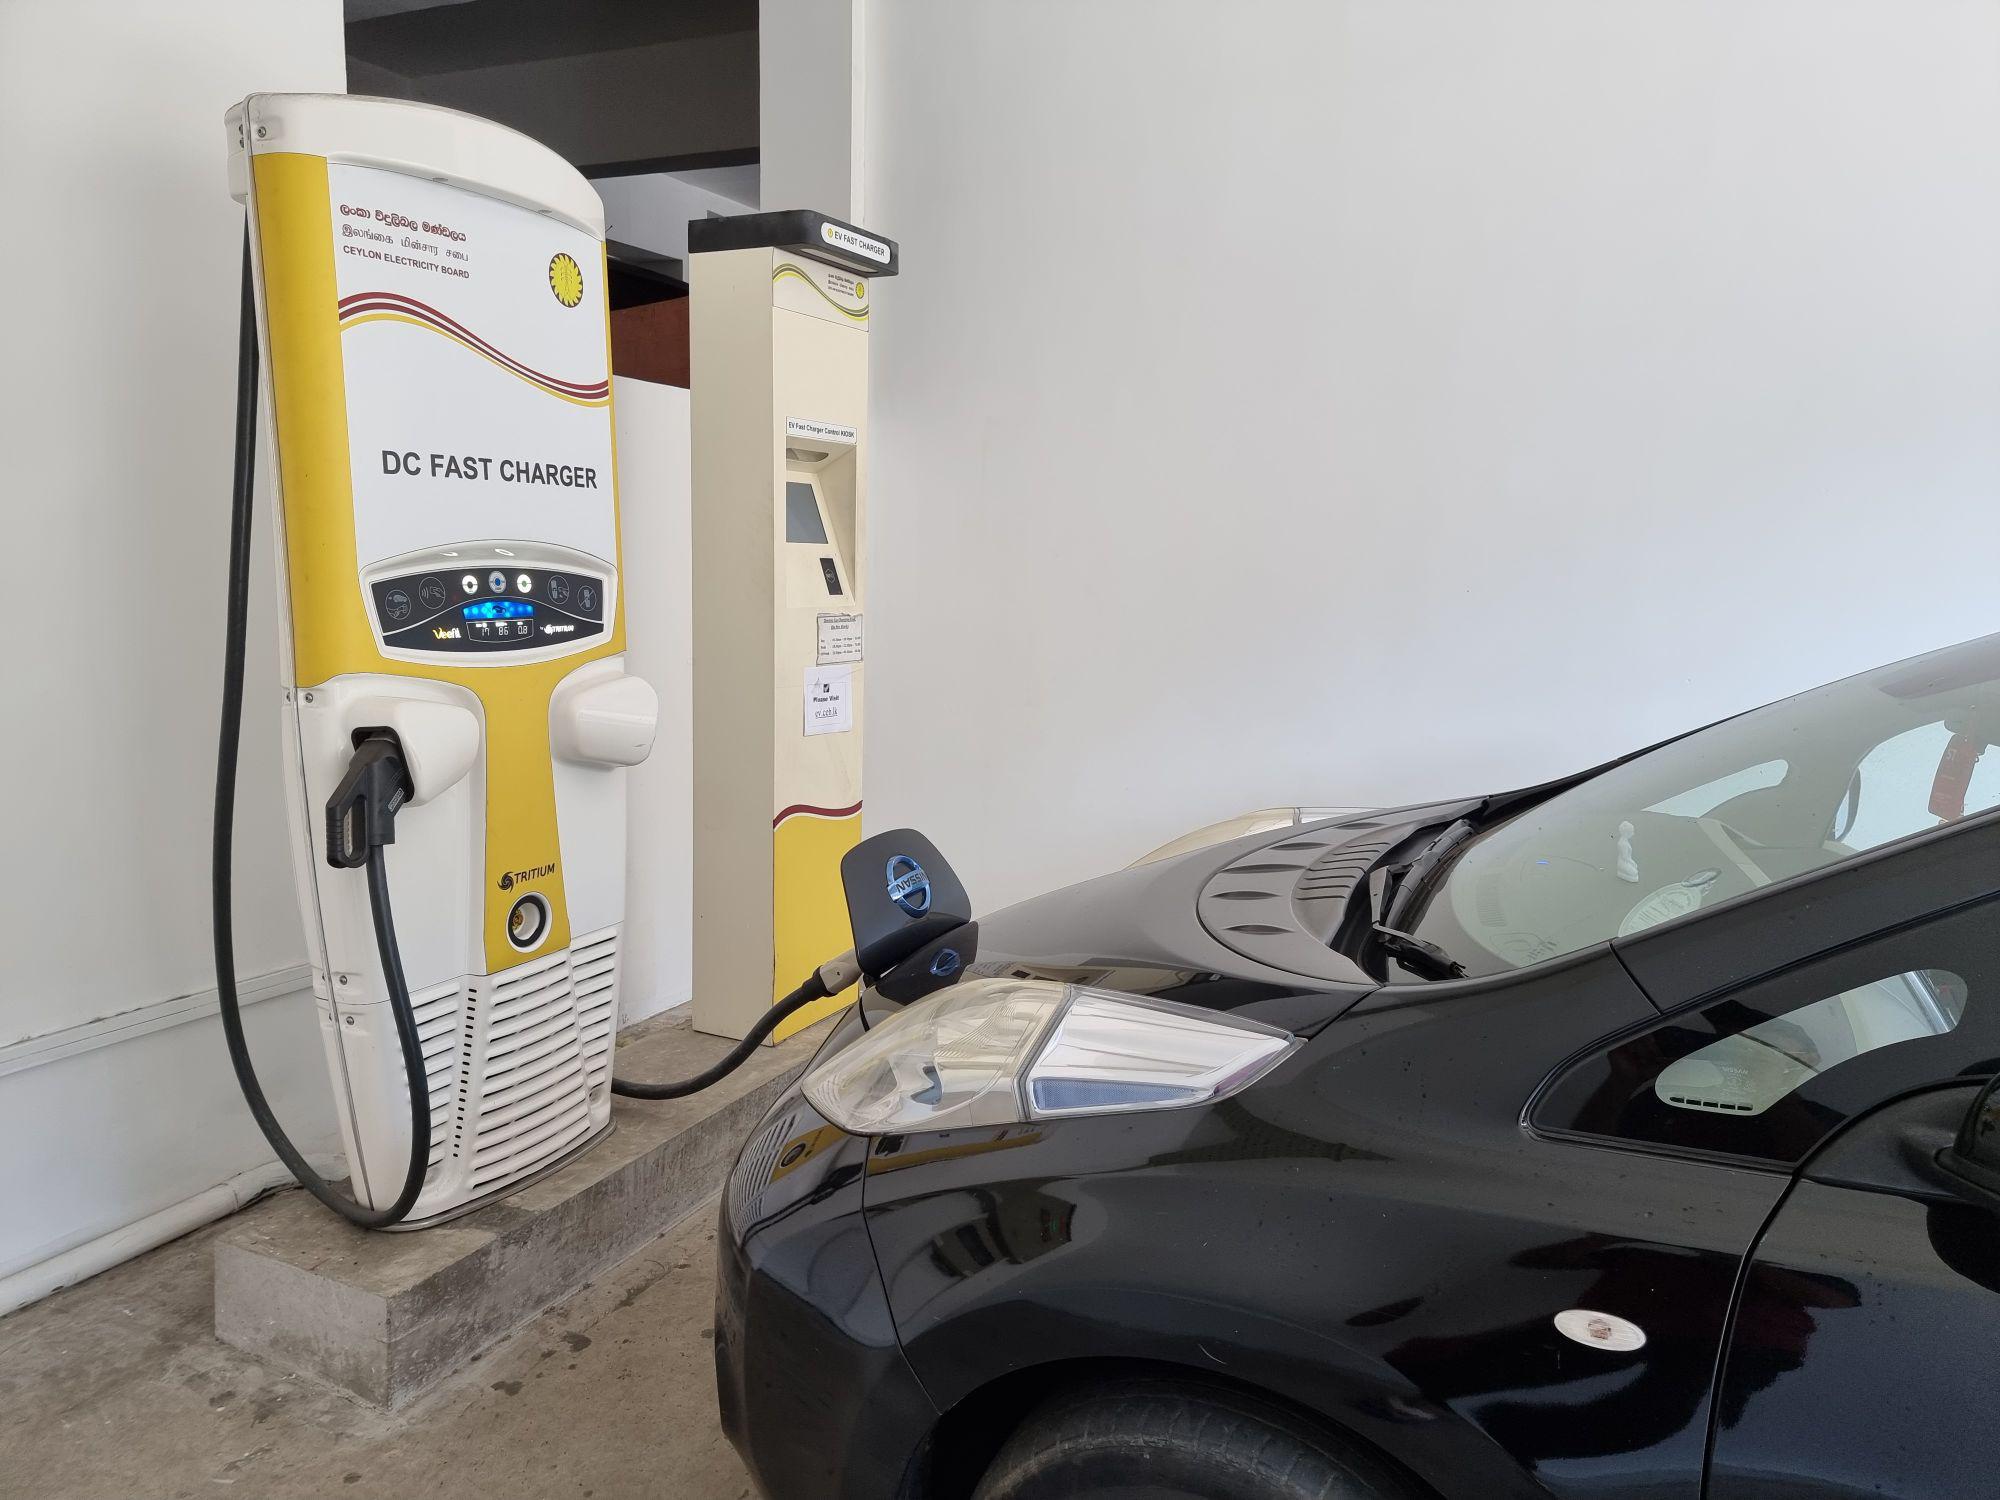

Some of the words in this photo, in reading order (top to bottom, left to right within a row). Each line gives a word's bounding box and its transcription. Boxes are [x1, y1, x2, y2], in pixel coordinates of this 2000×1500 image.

[340, 203, 371, 219] ලංකා
[342, 224, 394, 244] இலங்கை
[401, 236, 438, 256] மின்சார
[445, 248, 469, 262] சபை
[835, 231, 842, 240] EV
[844, 235, 858, 246] FAST
[859, 240, 884, 256] CHARGER
[343, 245, 382, 261] CEYLON
[384, 253, 439, 272] ELECTRICITY
[441, 265, 470, 279] BOARD
[806, 425, 824, 434] Charger
[841, 430, 854, 438] KIOSK
[381, 450, 421, 475] DC
[430, 453, 493, 481] FAST
[500, 459, 598, 489] CHARGER
[498, 626, 508, 635] 86
[513, 862, 556, 884] TRITIUM
